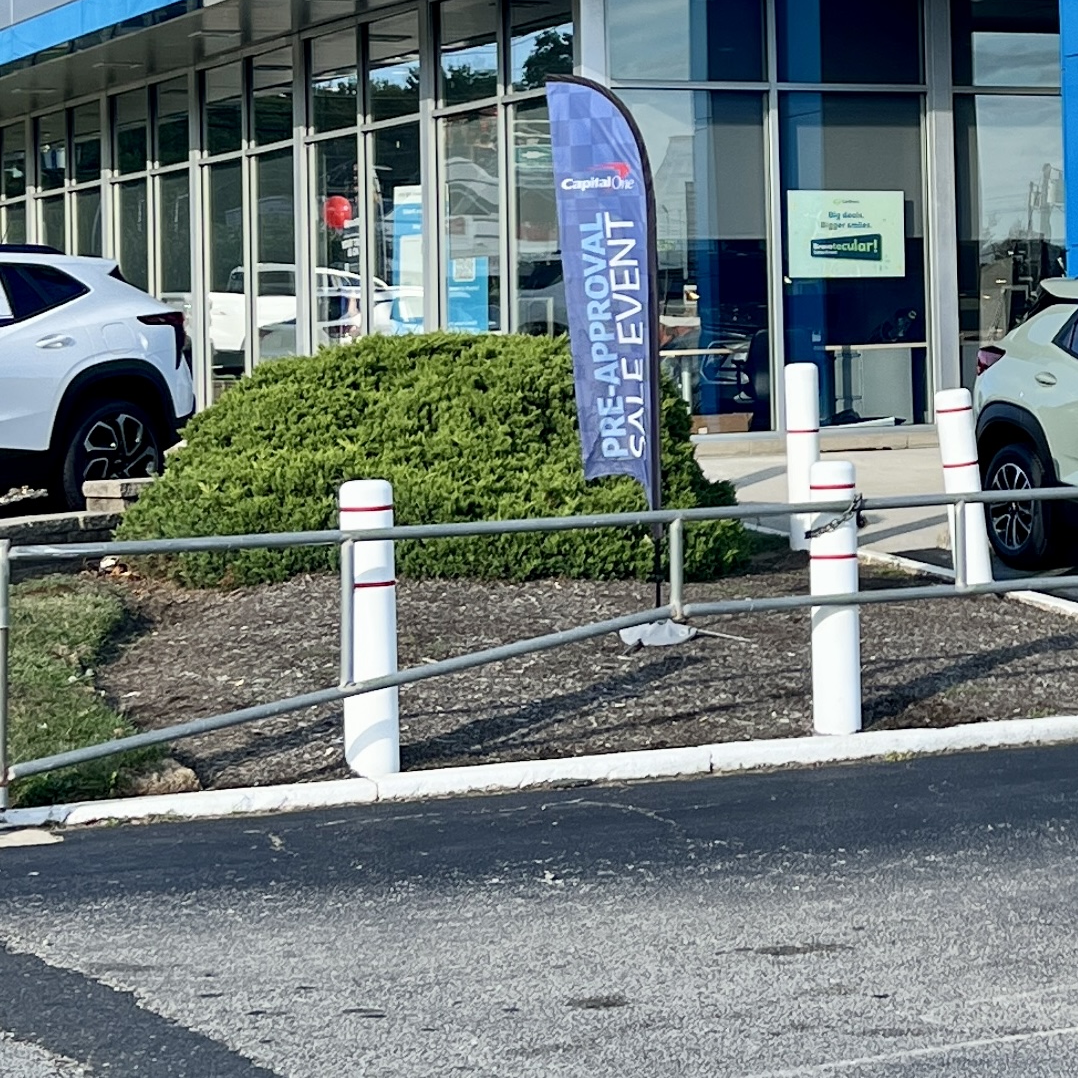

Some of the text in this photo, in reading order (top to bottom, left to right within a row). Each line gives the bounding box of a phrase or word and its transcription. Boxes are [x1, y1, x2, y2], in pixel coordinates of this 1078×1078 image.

[580, 212, 629, 458] PRE-APPROVAL
[604, 211, 646, 458] SALE EVENT
